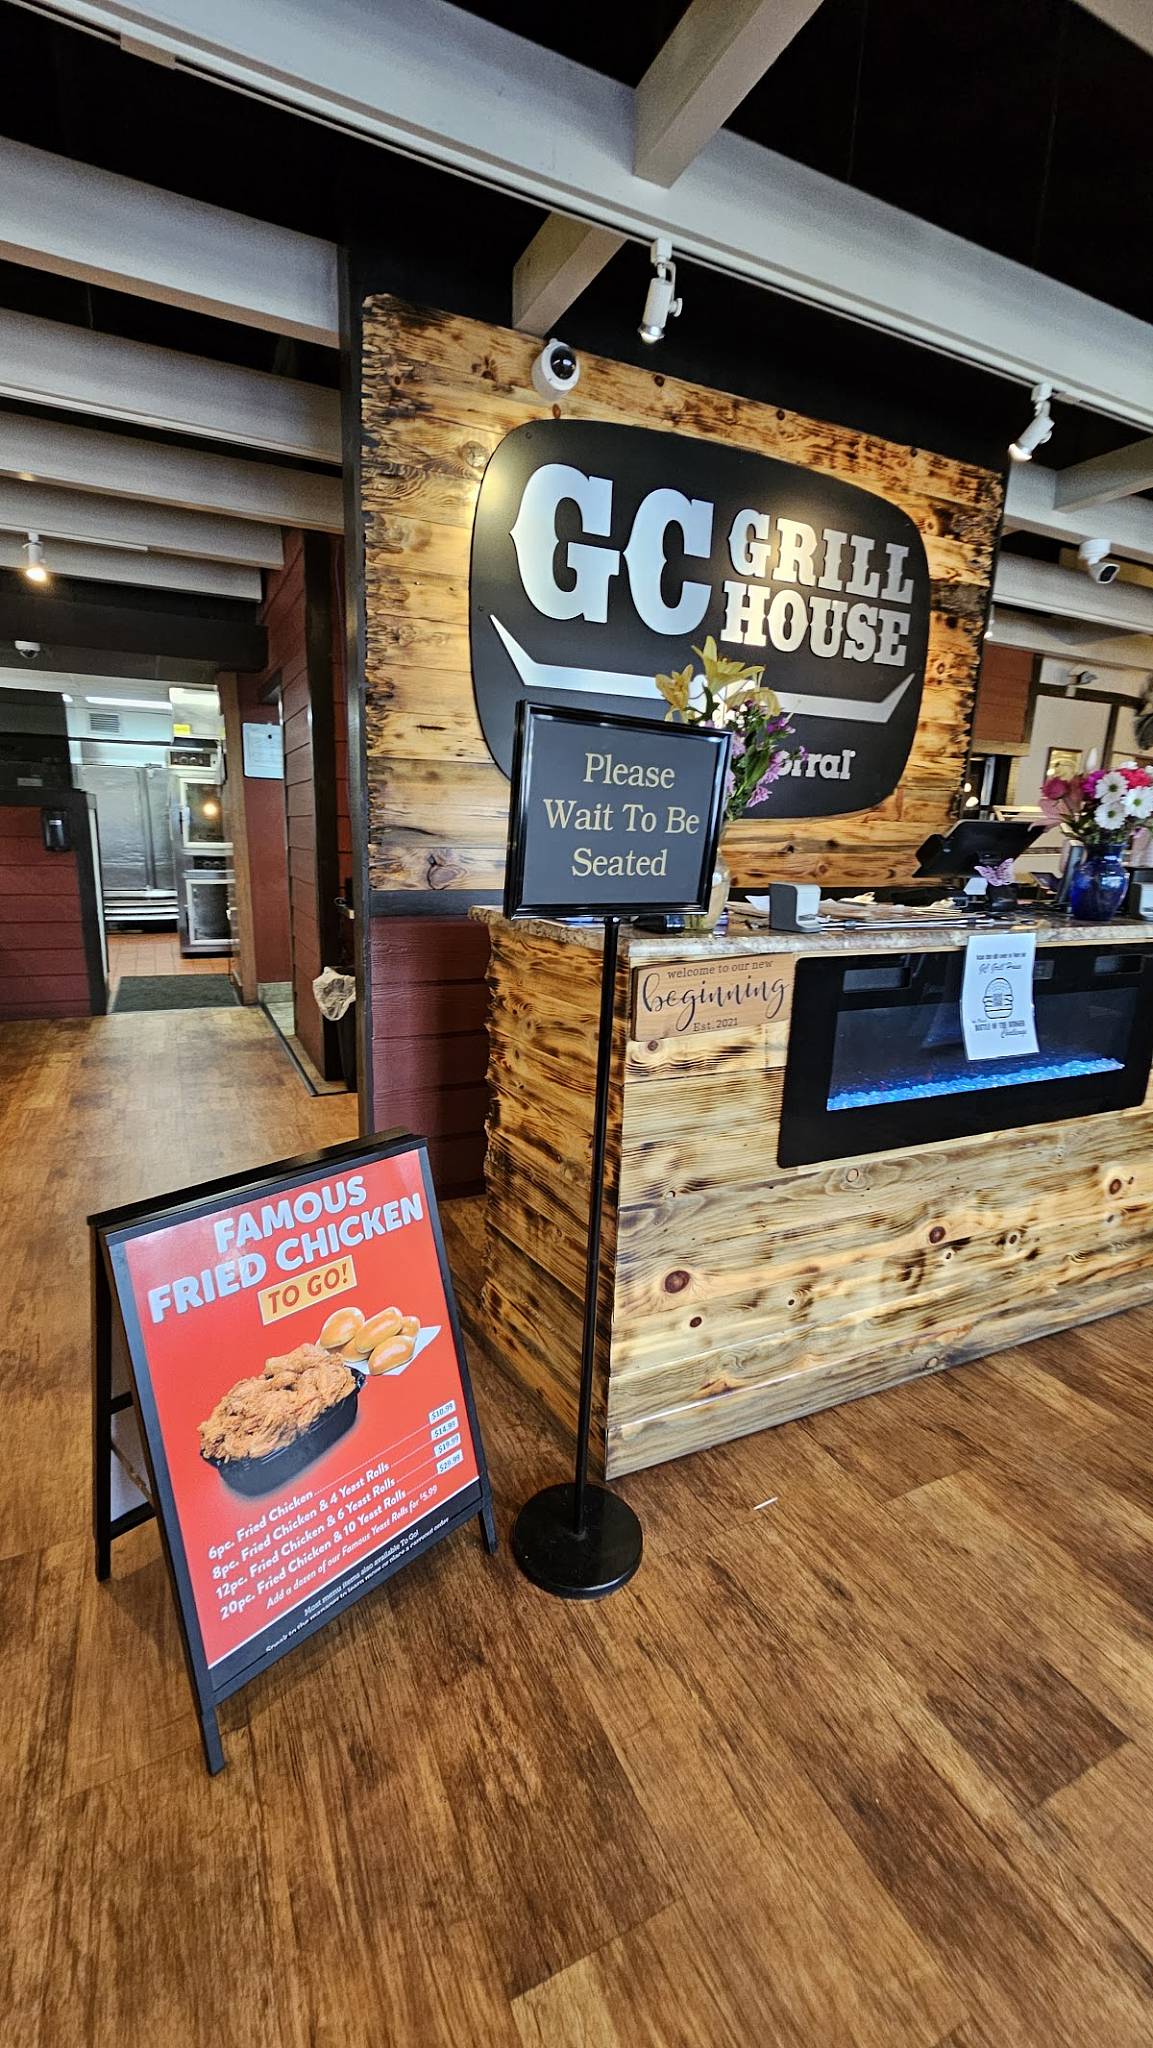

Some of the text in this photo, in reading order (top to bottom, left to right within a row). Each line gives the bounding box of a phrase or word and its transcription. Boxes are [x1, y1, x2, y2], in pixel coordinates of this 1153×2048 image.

[509, 463, 714, 636] GC
[728, 508, 914, 604] GRILL
[720, 581, 911, 666] HOUSE
[583, 753, 675, 789] Please
[543, 799, 700, 835] Wait To Be
[572, 848, 668, 876] Seated
[643, 972, 790, 1031] beginning
[668, 960, 774, 979] welcome to our new
[693, 1017, 738, 1031] Est. 2021
[214, 1175, 367, 1254] FAMOUS
[148, 1192, 423, 1324] FRIED CHICKEN
[268, 1263, 348, 1314] TO GO!
[208, 1491, 313, 1560] 6pc. Fried Chicken
[212, 1462, 389, 1579] 8pc. Fried Chicken & 4 Yeast Rolls
[216, 1477, 396, 1599] 12pc. Fried Chicken & 6 Yeast Rolls
[220, 1490, 406, 1621] 20pc. Fried Chicken & 10 Yeast Rolls
[266, 1484, 438, 1610] Add a dozen of our Famous Yeast Rolls for $5.99
[342, 1571, 360, 1589] items
[361, 1562, 374, 1576] also
[374, 1543, 400, 1566] available
[400, 1538, 409, 1547] To
